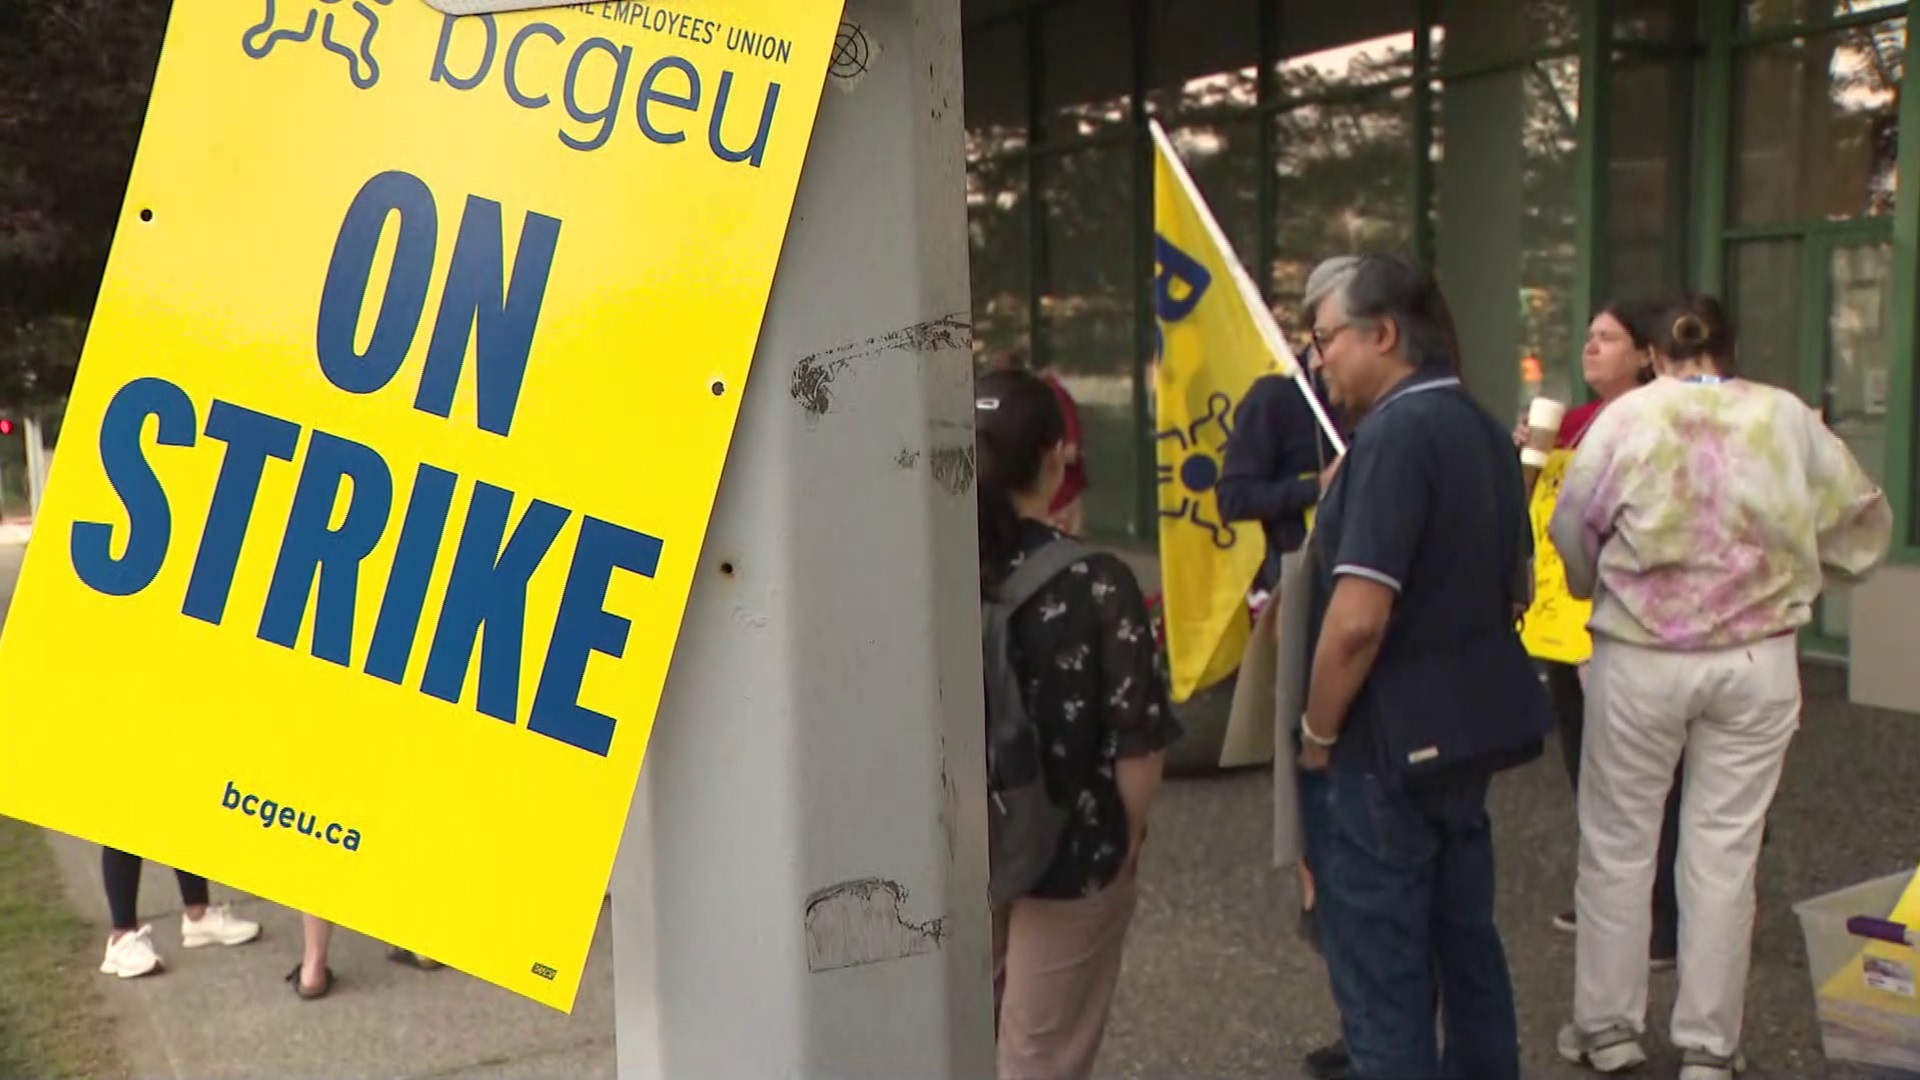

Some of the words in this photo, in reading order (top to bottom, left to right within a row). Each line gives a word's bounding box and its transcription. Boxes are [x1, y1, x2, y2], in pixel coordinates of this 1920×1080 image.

[430, 14, 781, 168] bcgeu
[602, 0, 721, 44] EMPLOYEES'
[726, 27, 792, 64] UNION
[317, 171, 562, 437] ON
[71, 377, 664, 757] STRIKE
[222, 780, 361, 852] bcgeu.ca
